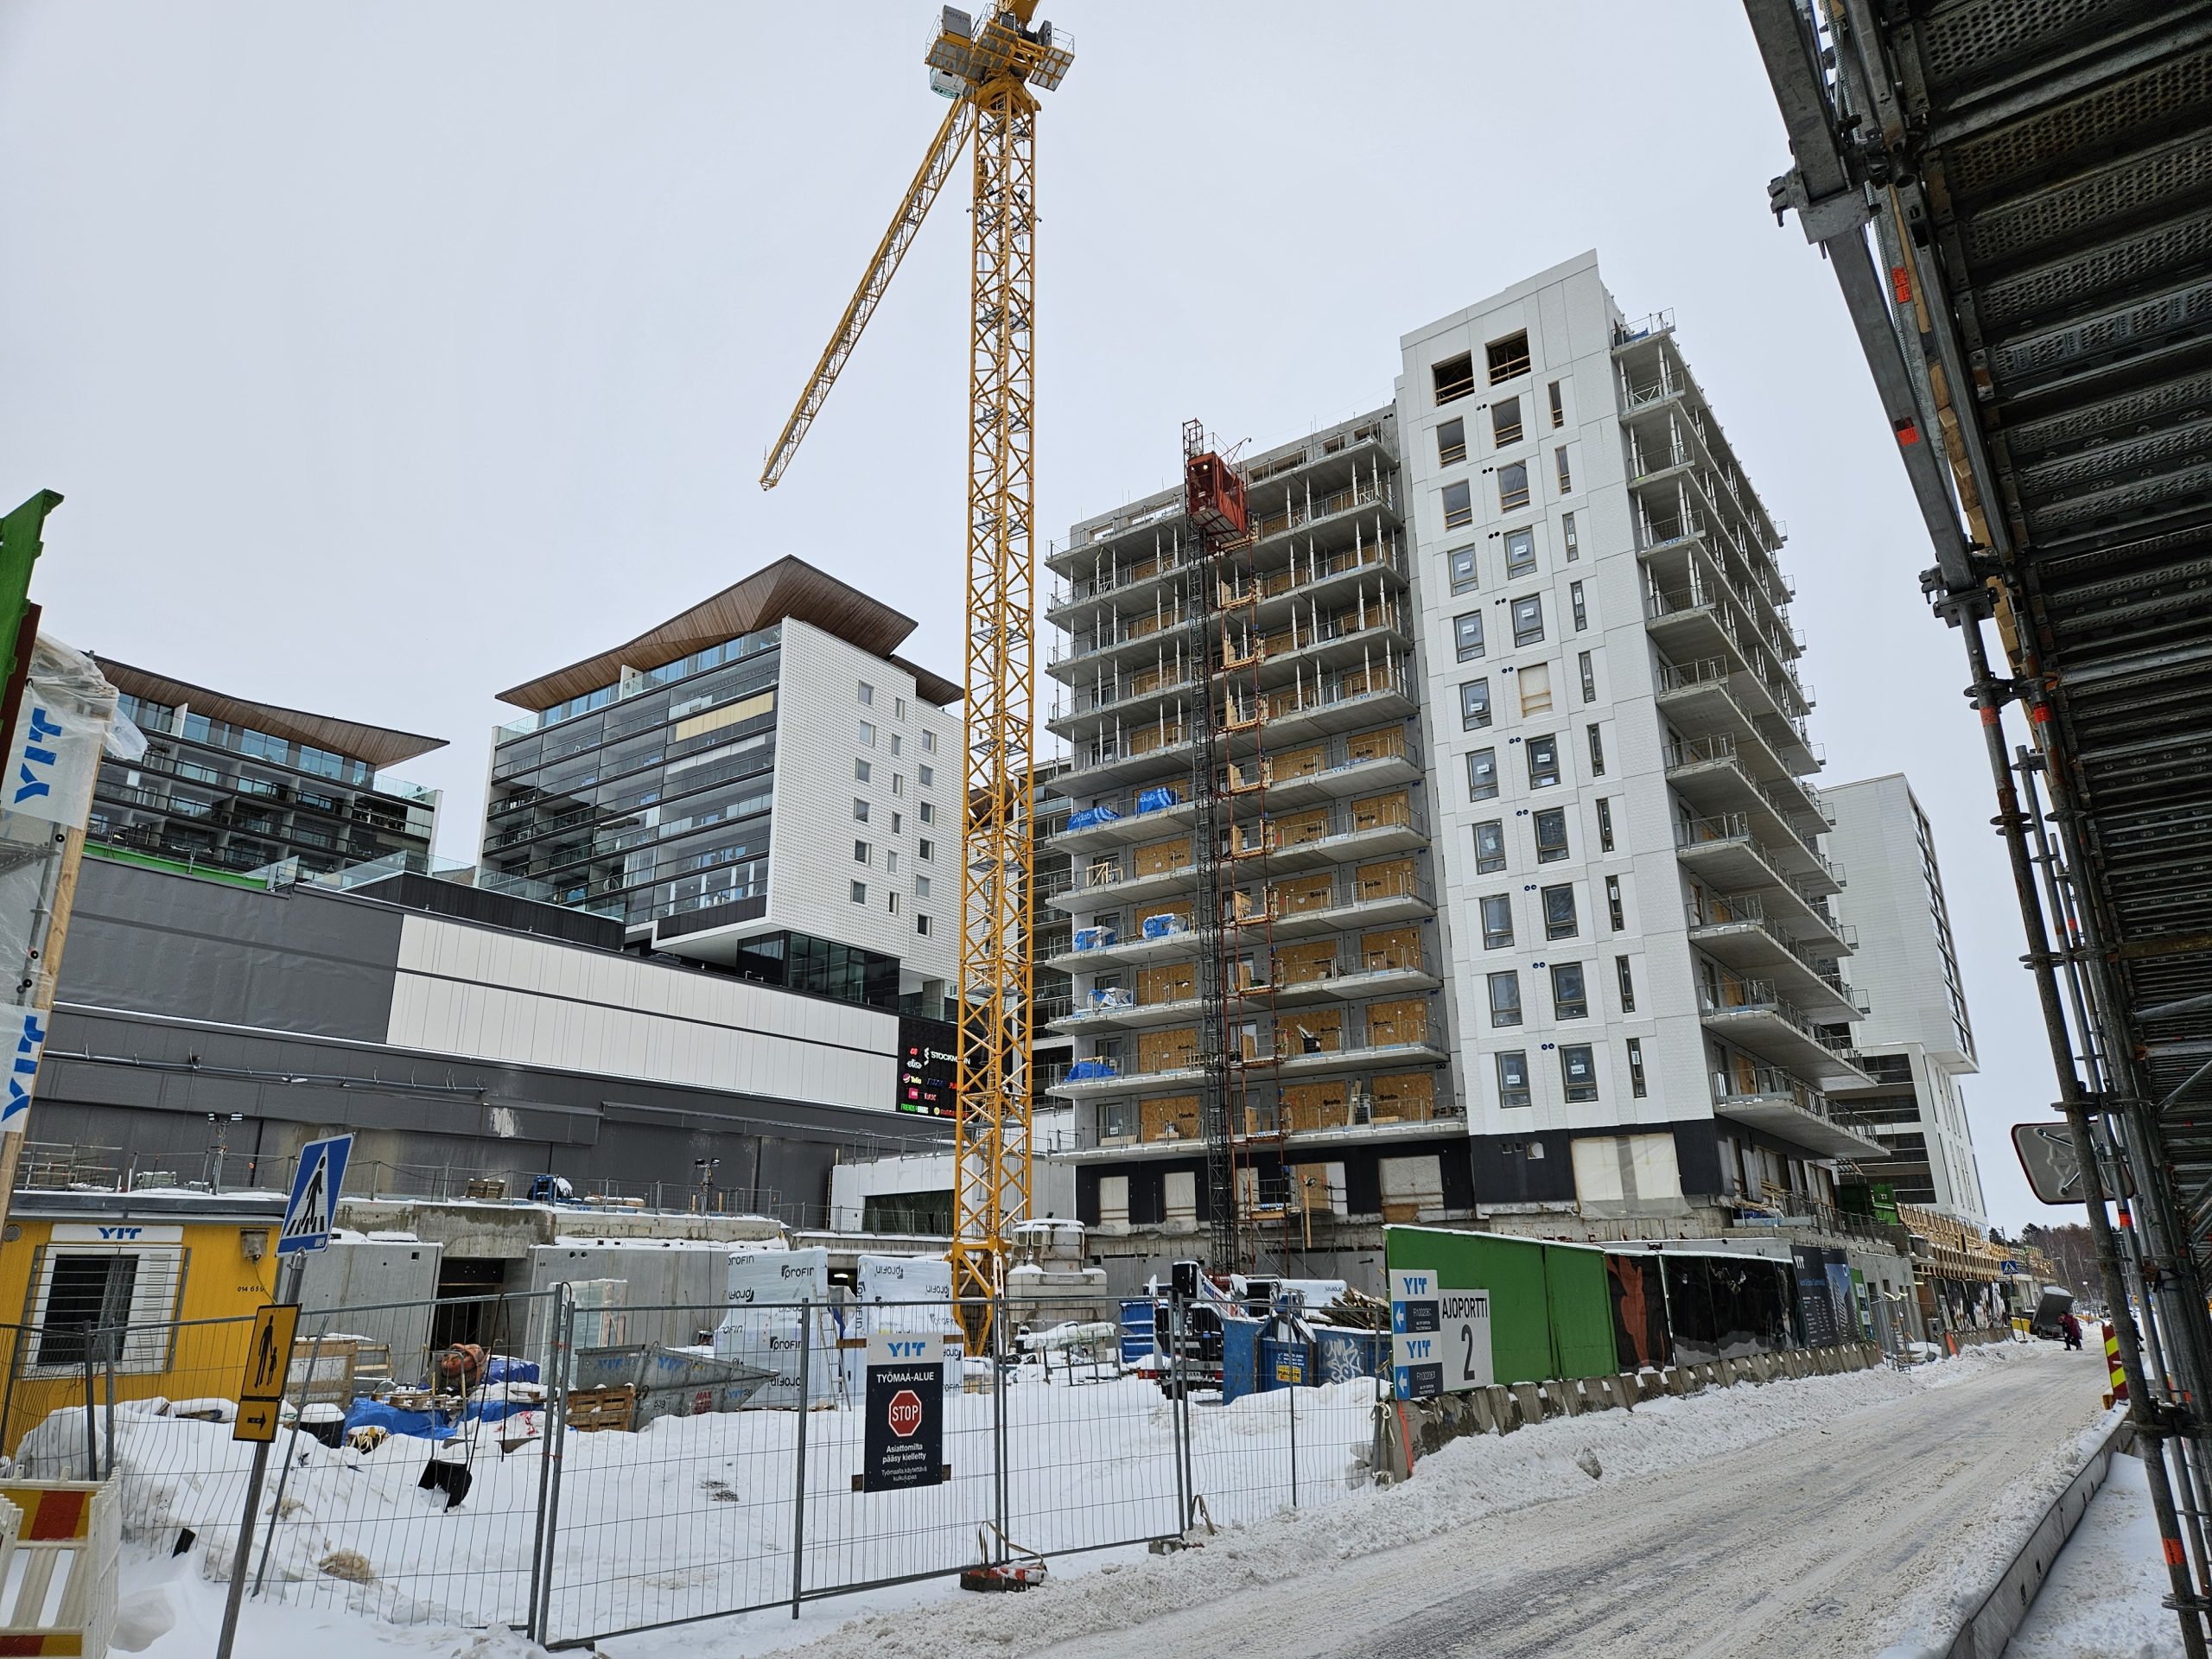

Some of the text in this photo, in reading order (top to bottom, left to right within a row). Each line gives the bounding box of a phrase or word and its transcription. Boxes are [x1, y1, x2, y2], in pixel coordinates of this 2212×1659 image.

[14, 708, 61, 804] YIT
[2, 1015, 45, 1122] YIT
[98, 1228, 142, 1239] YIT
[1794, 1255, 1804, 1269] YIT
[1403, 1278, 1427, 1294] YIT
[1442, 1298, 1488, 1319] AJOPORTTI
[887, 1341, 925, 1357] YIT
[1406, 1340, 1431, 1358] YIT
[1461, 1324, 1475, 1381] 2
[876, 1371, 934, 1383] TYÖMAA-ALUE
[892, 1404, 918, 1421] STOP
[887, 1443, 923, 1453] Asiattomilta
[882, 1452, 926, 1465] pääsy kielletty
